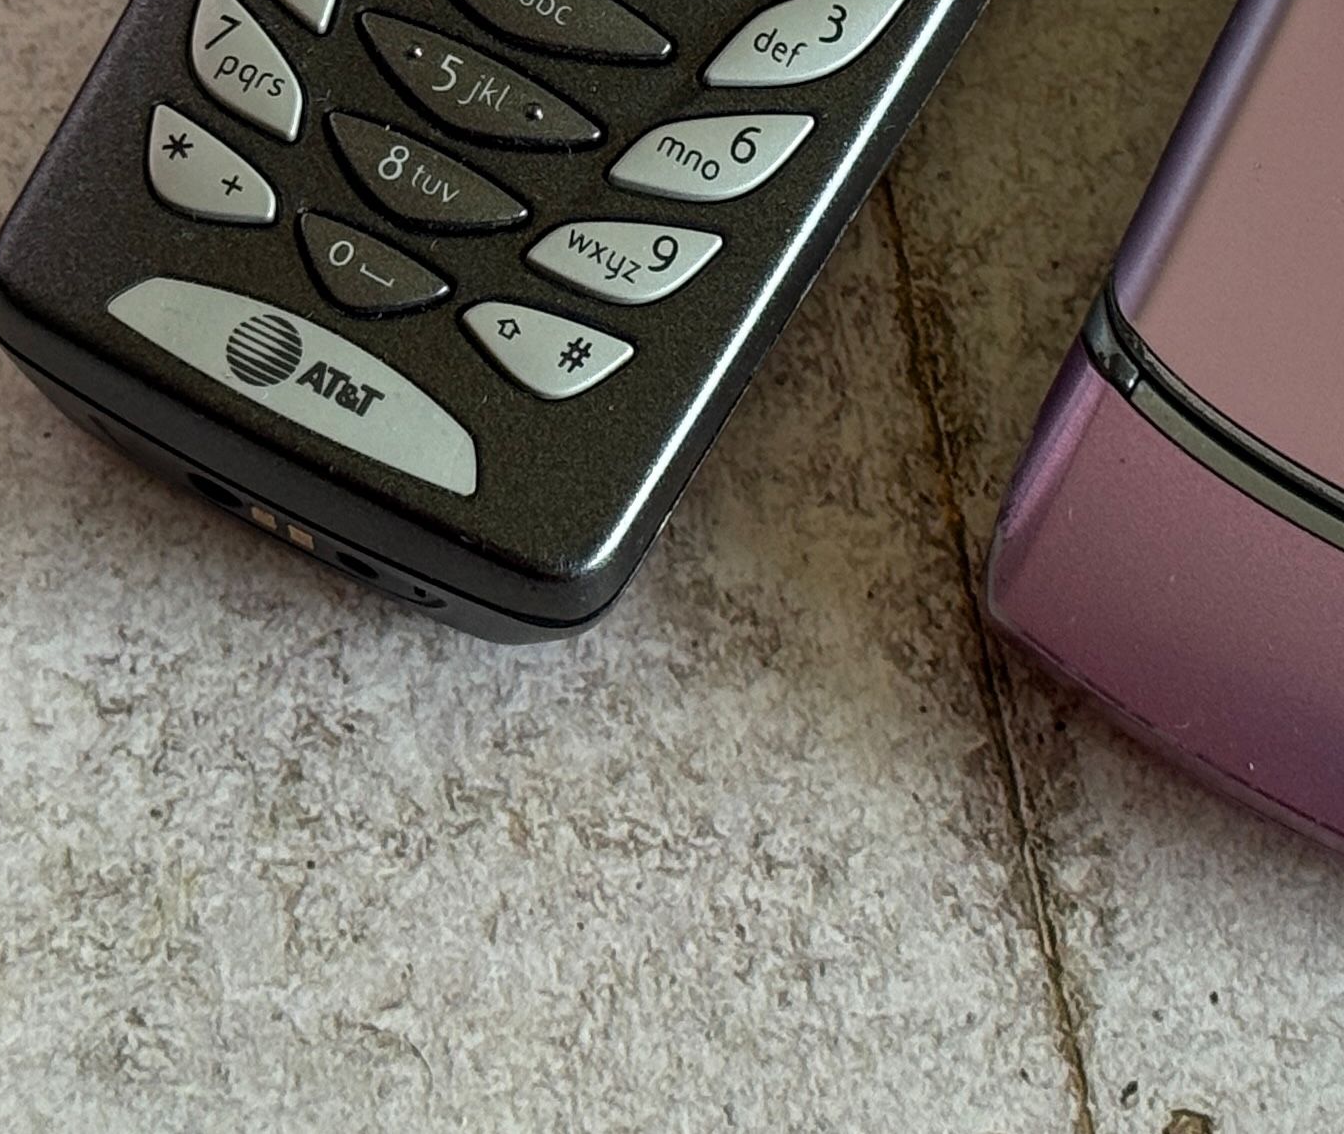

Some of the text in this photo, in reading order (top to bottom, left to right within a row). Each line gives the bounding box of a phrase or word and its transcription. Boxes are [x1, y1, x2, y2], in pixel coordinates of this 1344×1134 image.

[203, 13, 242, 50] 7
[752, 3, 850, 69] def 3
[213, 55, 285, 99] pqrs
[430, 53, 509, 113] 5 jkl
[377, 144, 461, 204] 8 tuv
[656, 125, 764, 182] mno 6
[567, 227, 679, 285] wxyz 9
[295, 360, 386, 418] AT&T
